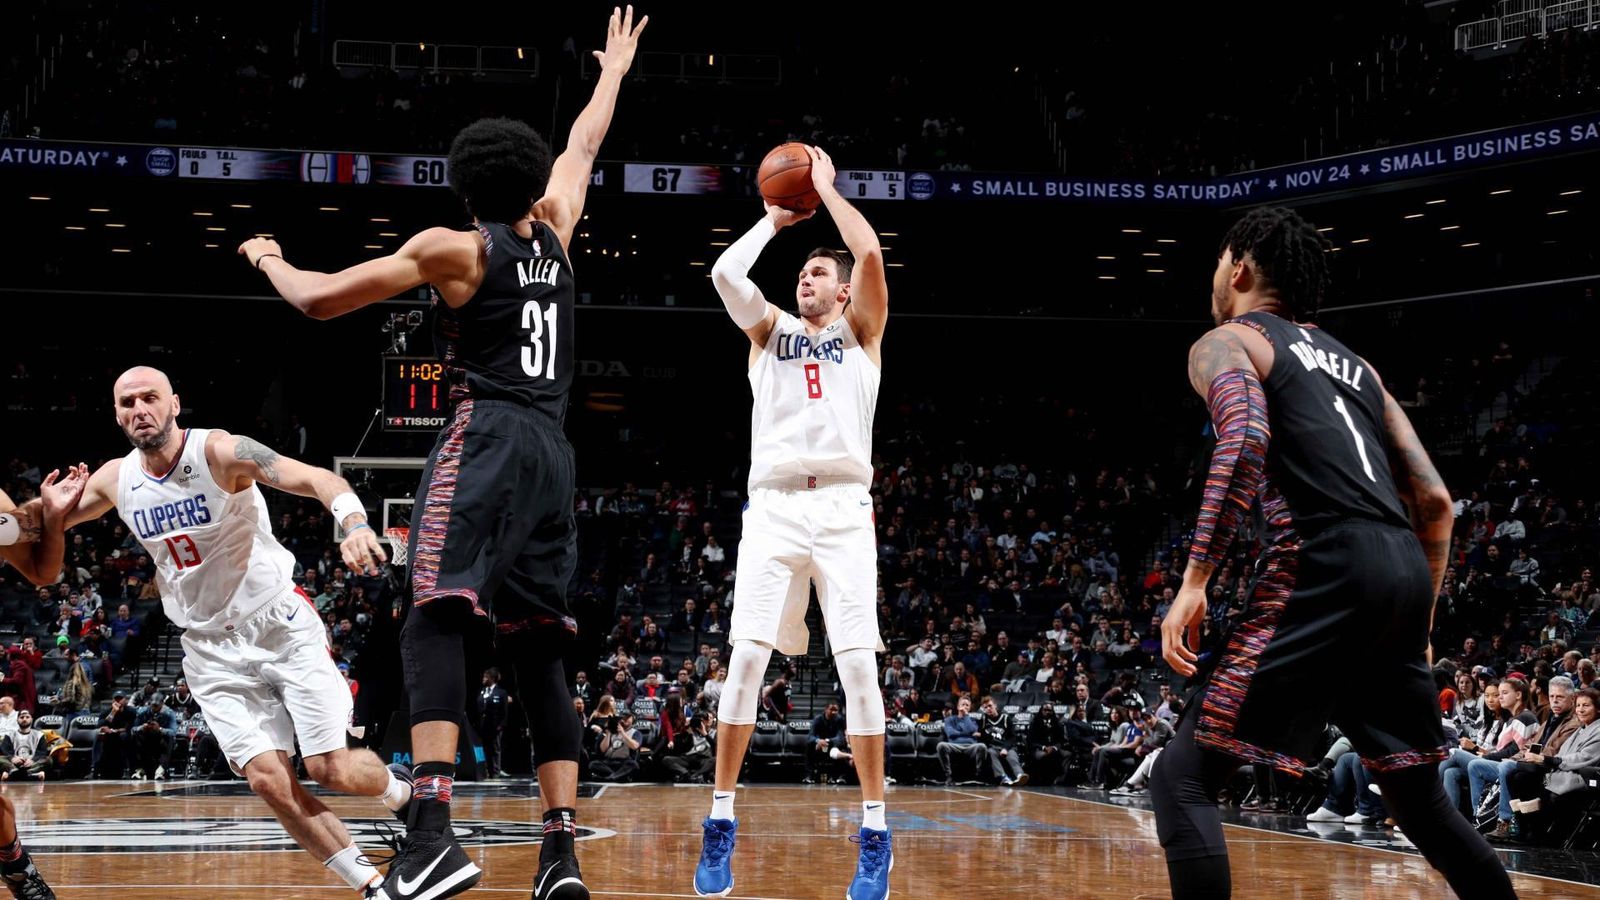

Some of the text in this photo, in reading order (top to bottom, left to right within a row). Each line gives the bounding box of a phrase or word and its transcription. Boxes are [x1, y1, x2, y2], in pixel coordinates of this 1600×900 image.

[181, 149, 207, 159] FOULS
[1379, 121, 1600, 174] SMALL BUSINESS SA
[190, 161, 199, 175] 0
[222, 162, 231, 176] 5
[413, 160, 445, 185] 60
[652, 168, 682, 192] 67
[849, 171, 873, 181] FOULS
[1285, 164, 1350, 189] NOV 24
[858, 183, 866, 197] 0
[888, 183, 897, 198] 5
[972, 180, 1038, 196] SMALL
[1045, 181, 1146, 198] BUSINESS
[516, 258, 560, 288] ALLEN
[520, 300, 558, 380] 31
[400, 363, 442, 380] 11:02
[803, 363, 823, 399] 8
[410, 383, 438, 410] 11
[403, 417, 447, 426] TISSOT
[1333, 394, 1377, 483] 1
[133, 493, 212, 539] CLIPPERS
[163, 533, 202, 571] 13
